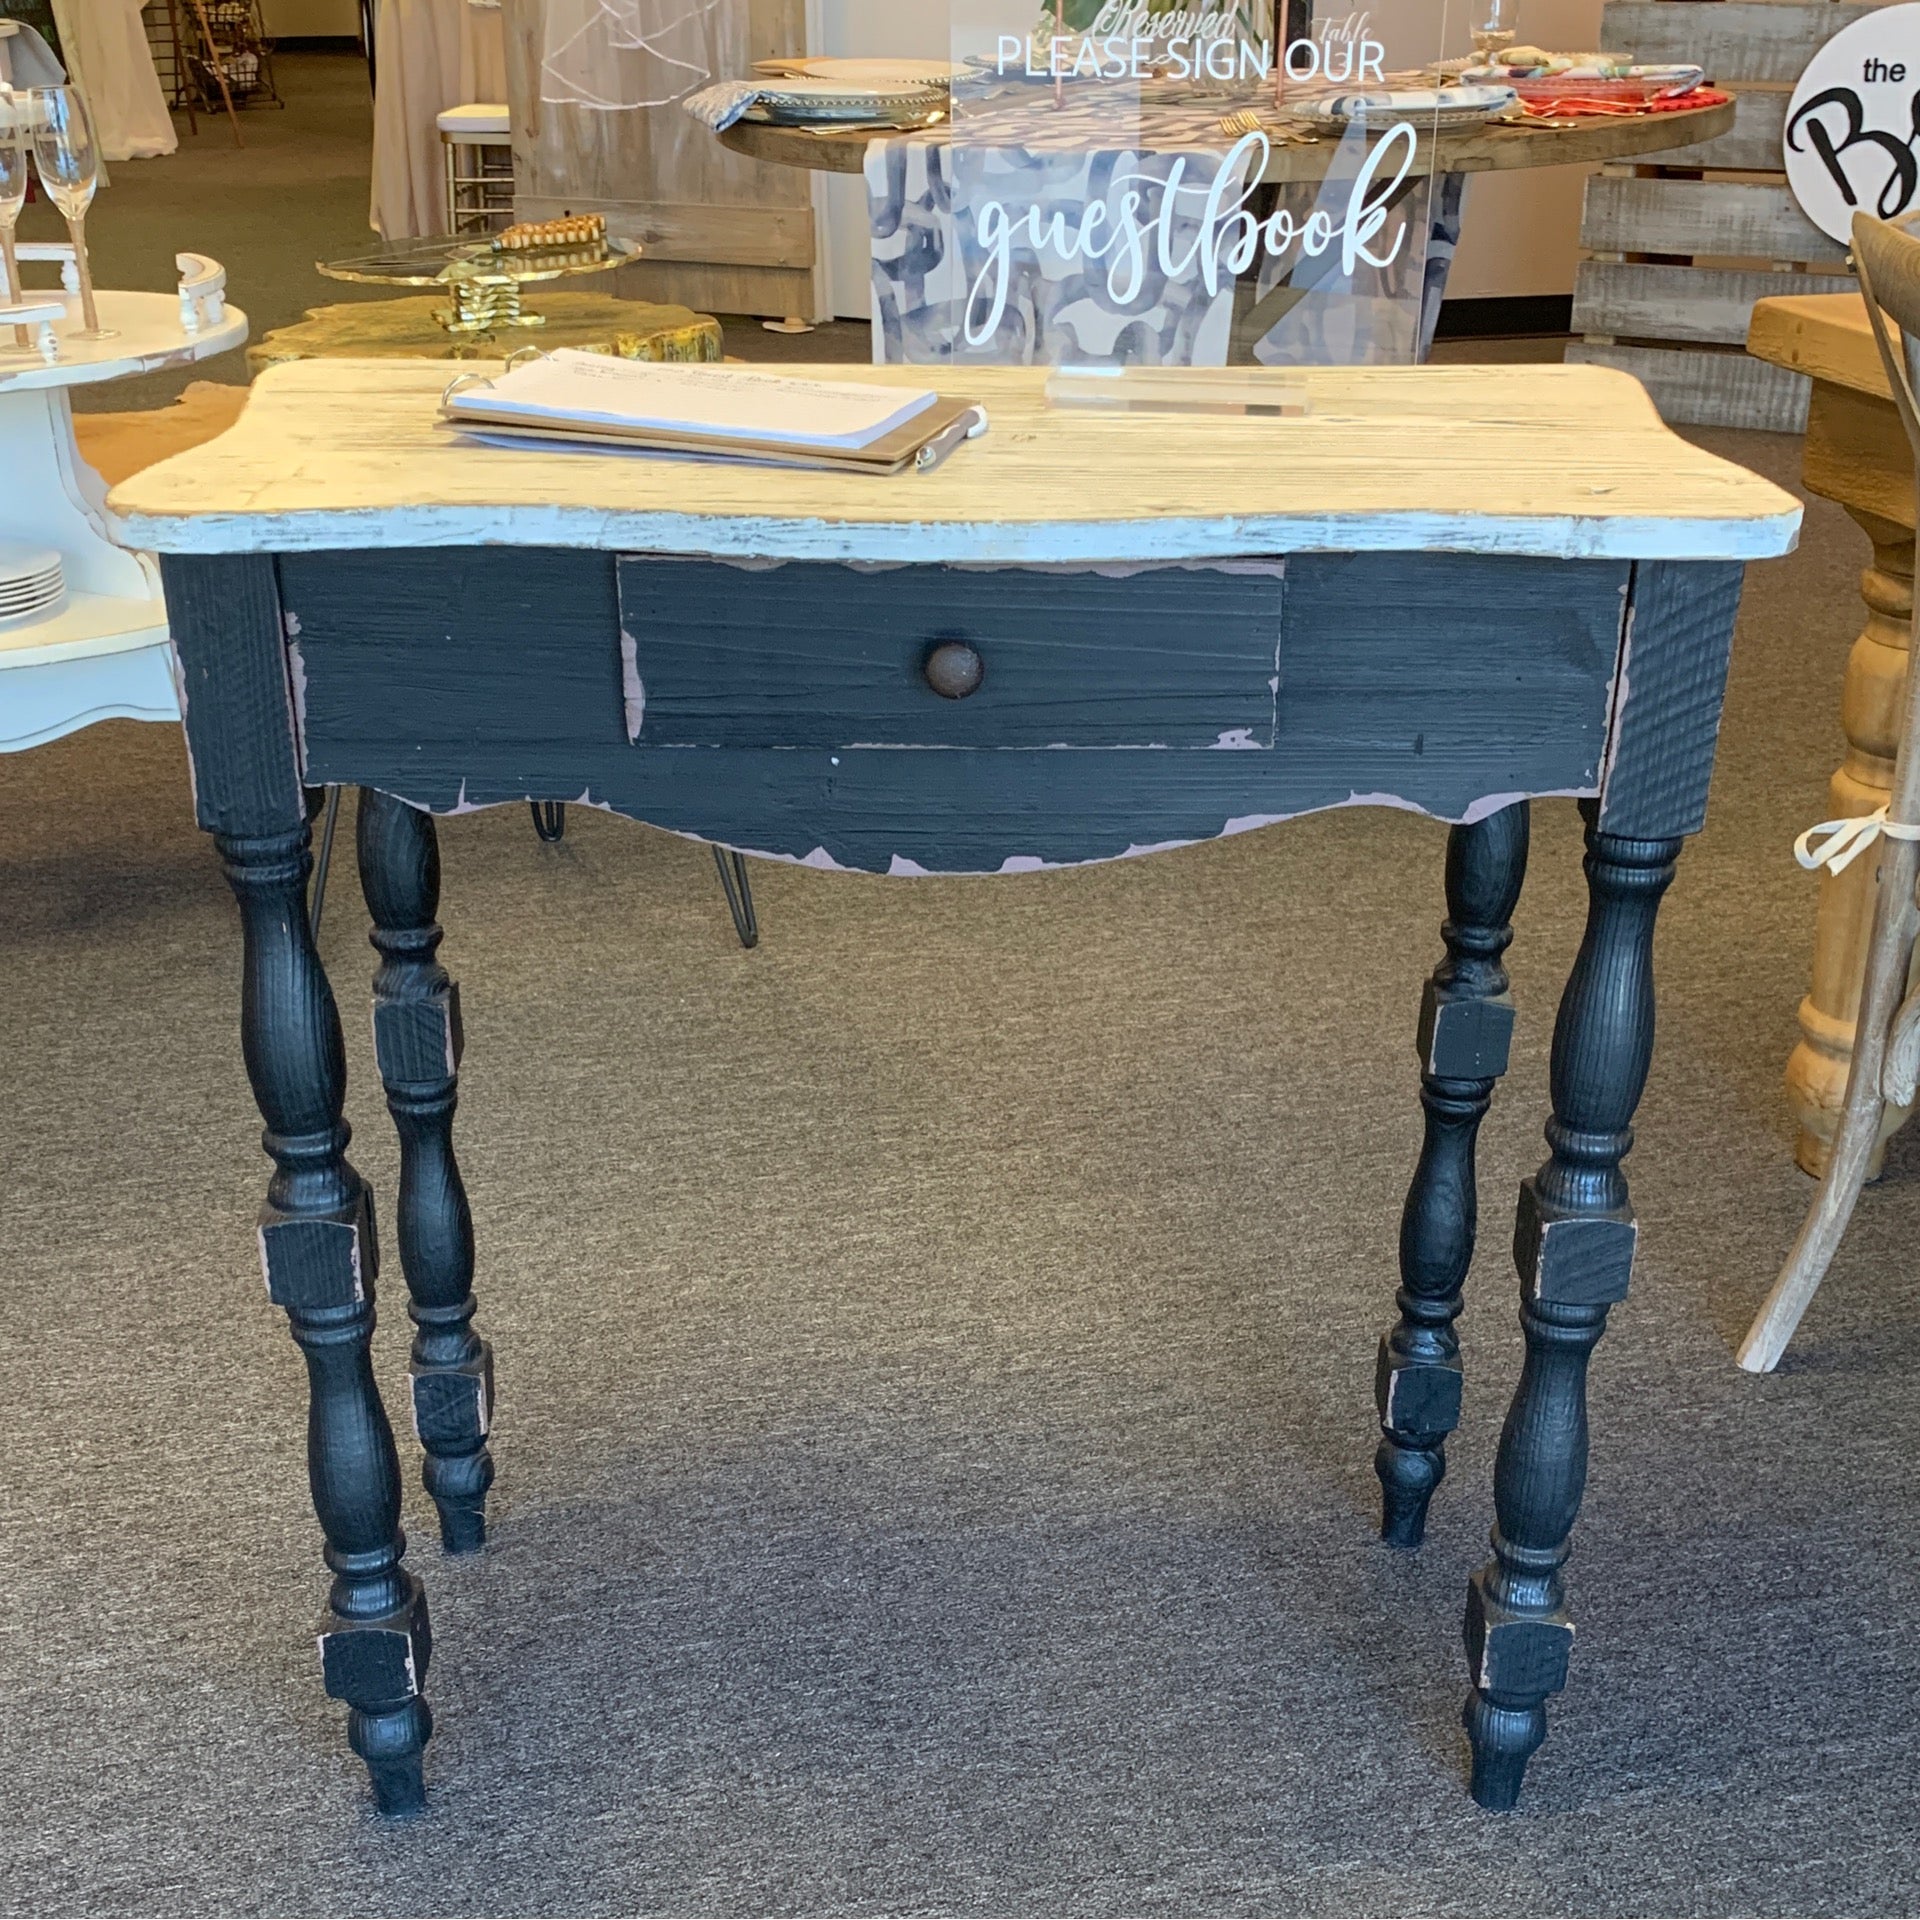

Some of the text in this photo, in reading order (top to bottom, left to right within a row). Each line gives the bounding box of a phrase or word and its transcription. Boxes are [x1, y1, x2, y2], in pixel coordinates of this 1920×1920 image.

[1092, 0, 1239, 46] Reserved
[1311, 11, 1371, 44] Table
[997, 35, 1385, 82] PLEASE SIGN OUR
[1863, 58, 1906, 83] the
[1787, 87, 1920, 219] B
[964, 122, 1417, 346] guestbook
